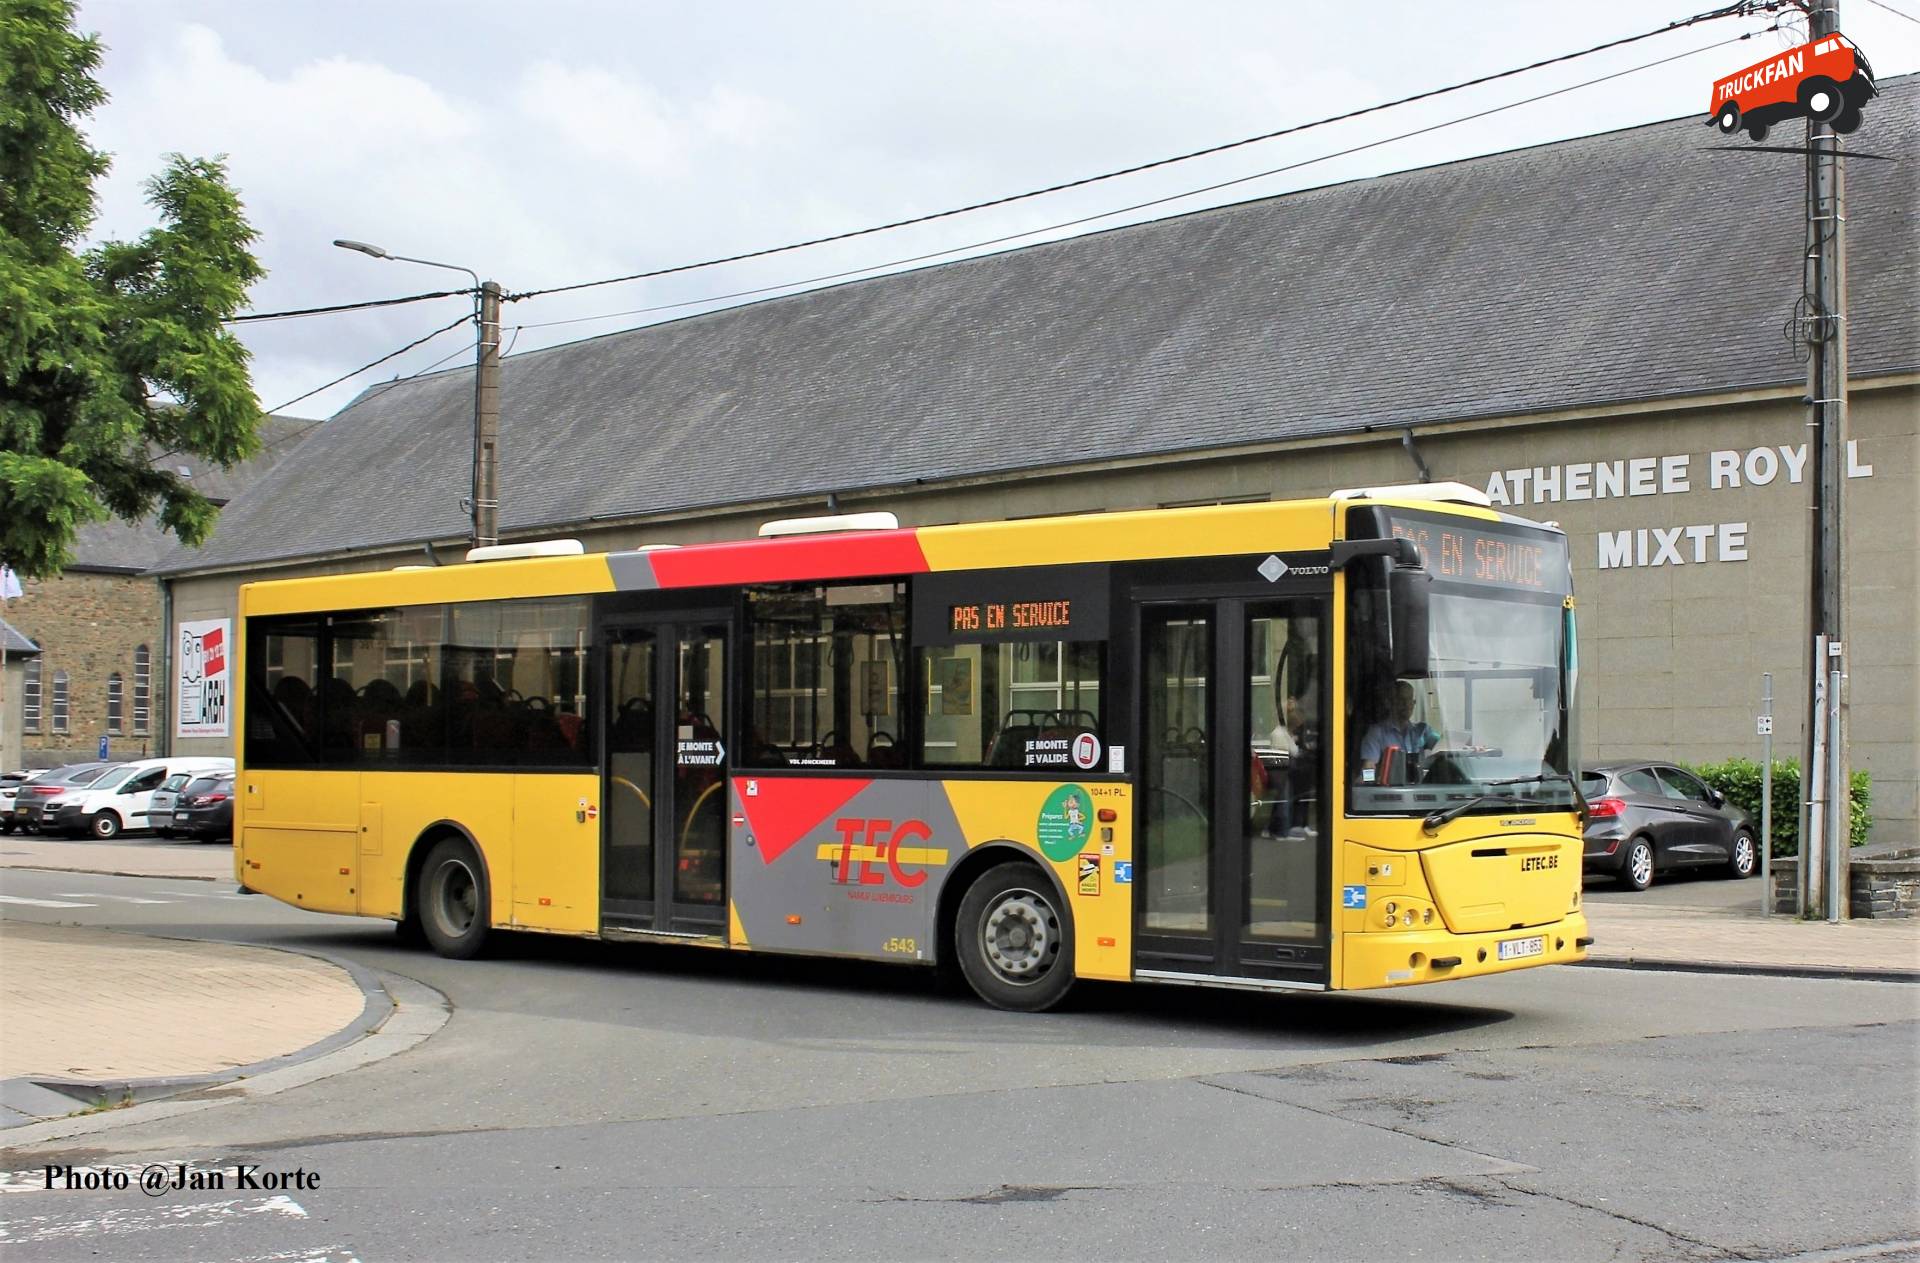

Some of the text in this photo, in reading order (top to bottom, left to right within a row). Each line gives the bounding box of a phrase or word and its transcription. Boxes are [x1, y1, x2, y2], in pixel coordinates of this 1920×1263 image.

[1485, 440, 1873, 506] ATHENEE ROYL
[1598, 522, 1749, 569] MIXTE
[1288, 565, 1329, 576] VOLVO
[1440, 532, 1464, 576] EN
[1474, 538, 1545, 587] SERVICE
[953, 601, 1070, 630] PAS EN SERVICE
[202, 680, 225, 724] ARBH
[678, 742, 713, 753] JE MONTE
[1025, 739, 1068, 751] JE MONTE
[678, 754, 716, 765] À L'AVANT
[1025, 753, 1068, 765] JE VALIDE
[836, 818, 933, 888] TEC
[1521, 855, 1559, 872] LETEC.BE
